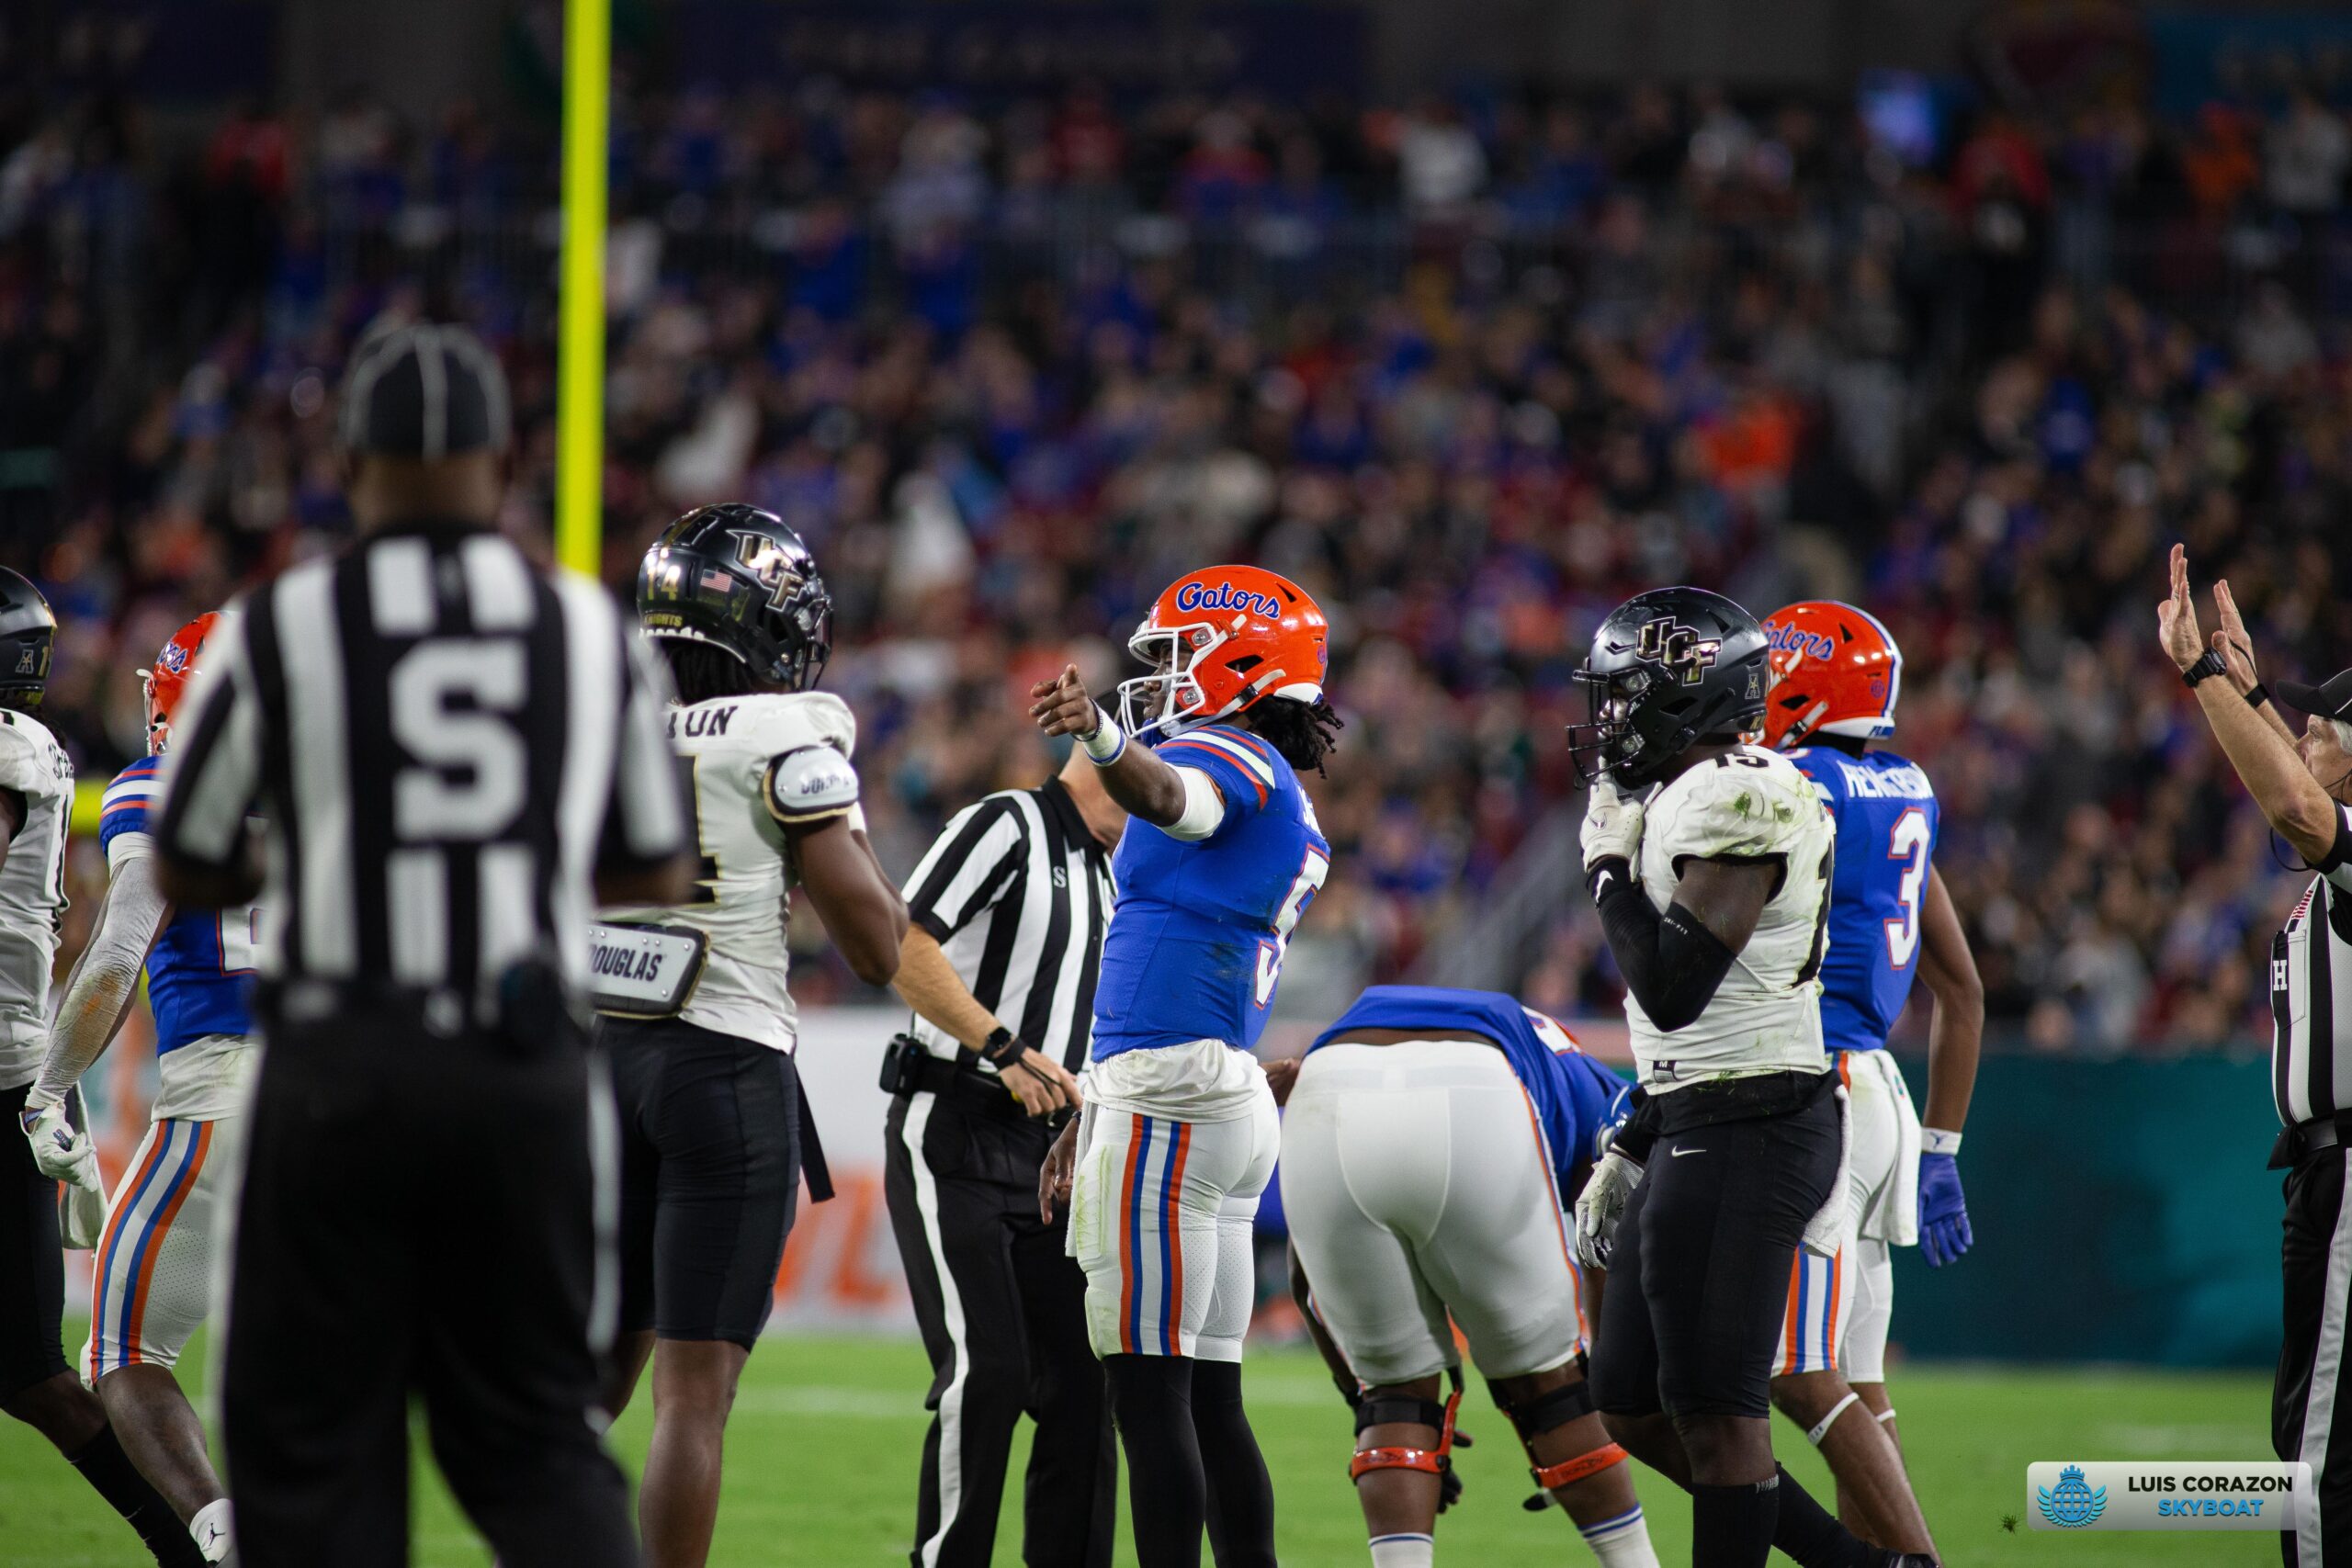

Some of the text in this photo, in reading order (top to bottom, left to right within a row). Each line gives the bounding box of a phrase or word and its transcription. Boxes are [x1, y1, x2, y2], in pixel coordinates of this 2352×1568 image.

[647, 563, 681, 601] 14
[1177, 581, 1281, 619] Gators
[1635, 616, 1723, 686] UCF
[1762, 620, 1836, 661] ators
[387, 637, 530, 840] S
[1053, 865, 1067, 888] S
[1884, 807, 1930, 971] 3
[1254, 842, 1331, 1010] 5
[2273, 959, 2288, 991] H
